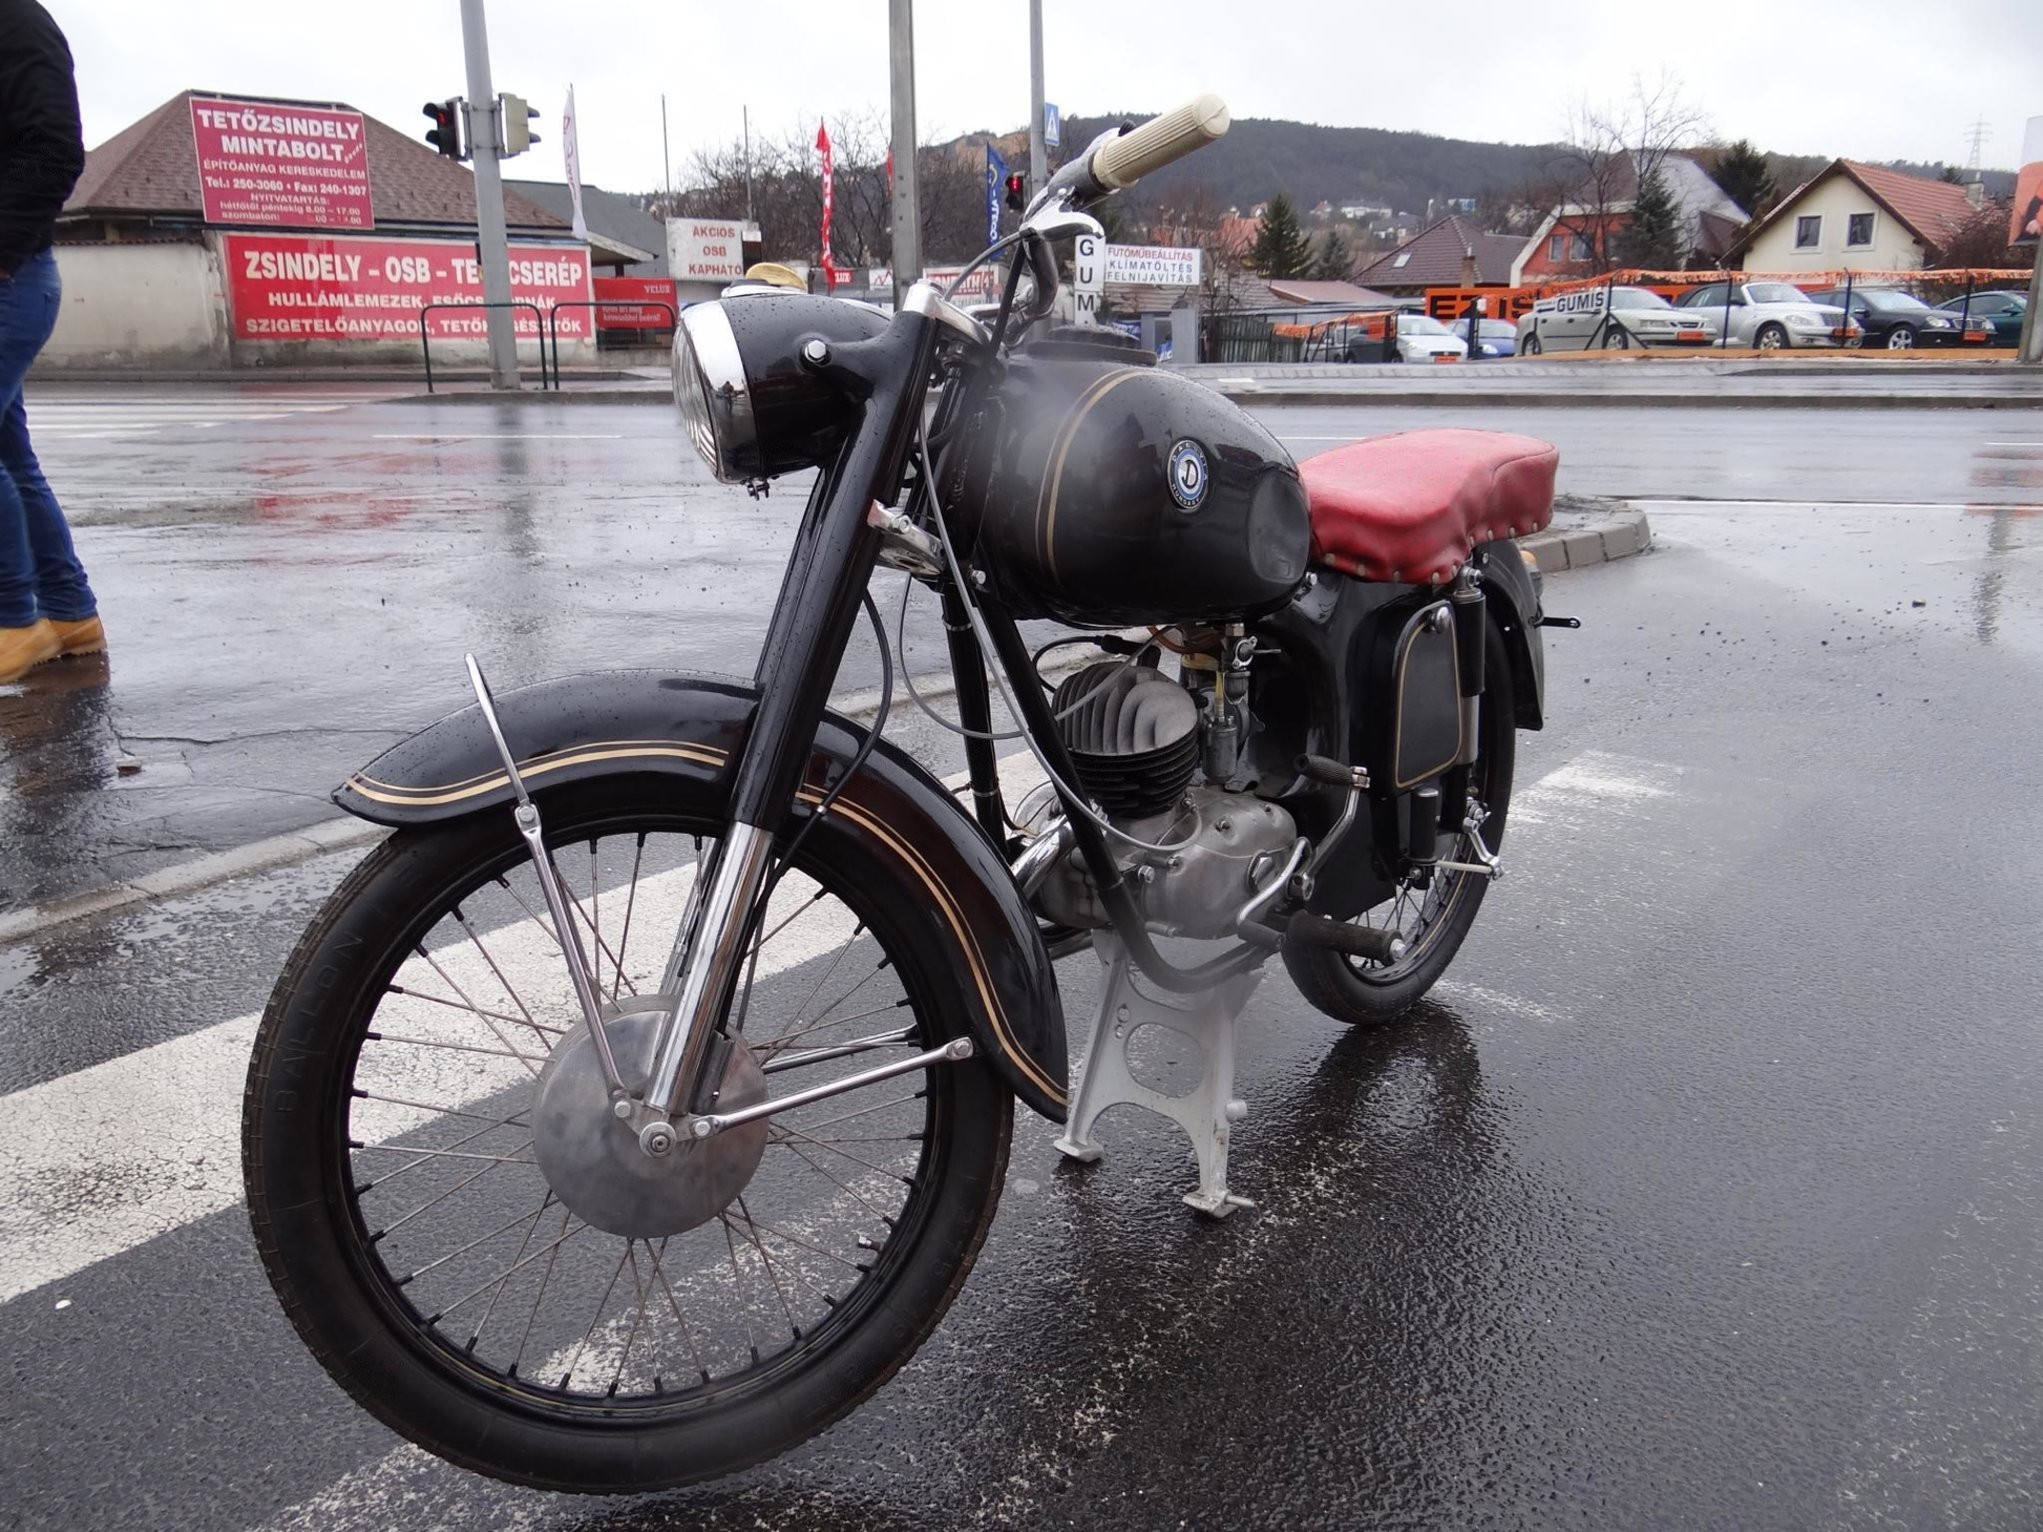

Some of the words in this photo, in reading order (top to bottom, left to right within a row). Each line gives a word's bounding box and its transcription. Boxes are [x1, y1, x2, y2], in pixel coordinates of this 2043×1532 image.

[197, 109, 360, 140] TETŐZSINDELY
[221, 135, 344, 162] MINTABOLT
[278, 165, 366, 179] KERESKEDELEM
[320, 183, 367, 196] 240-1307
[703, 246, 728, 257] OSB
[244, 250, 362, 282] ZSINDELY
[385, 256, 431, 283] OSB
[451, 256, 582, 287] TECSERÉP
[1107, 271, 1193, 284] FELNIJAVÍTÁS
[644, 285, 671, 294] VELUX
